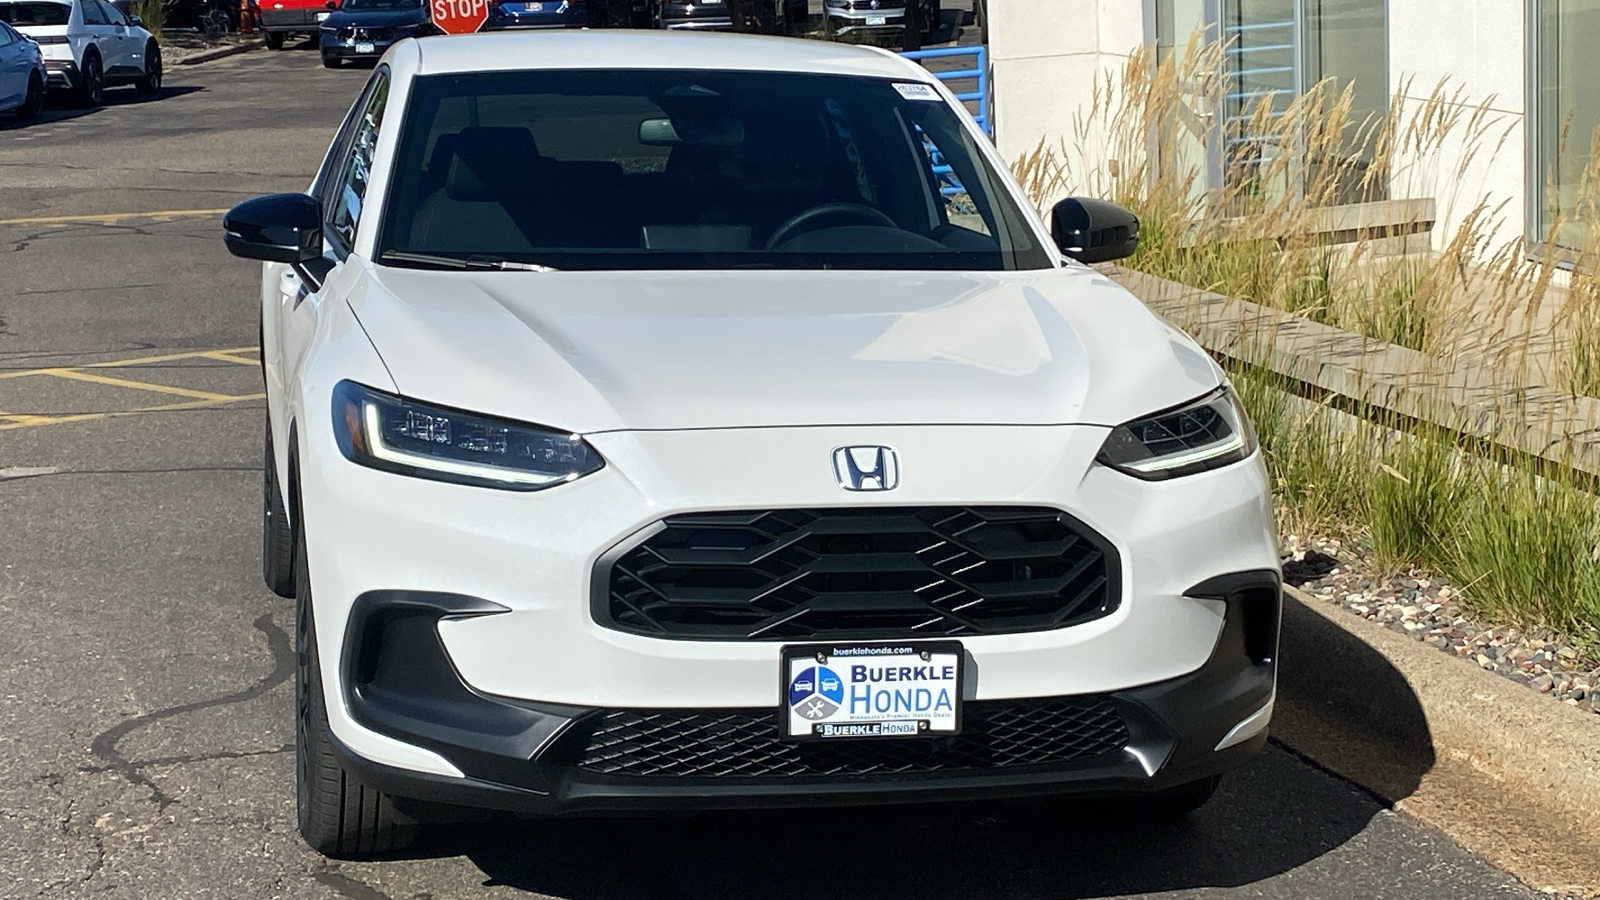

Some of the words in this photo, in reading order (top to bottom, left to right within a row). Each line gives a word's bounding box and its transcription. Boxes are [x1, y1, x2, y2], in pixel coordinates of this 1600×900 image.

[435, 0, 483, 20] STOP
[832, 647, 913, 656] buerklehonda.com
[851, 664, 954, 683] BUERKLE
[850, 684, 953, 714] HONDA
[824, 724, 880, 735] BUERKLE
[882, 723, 916, 733] HONDA
